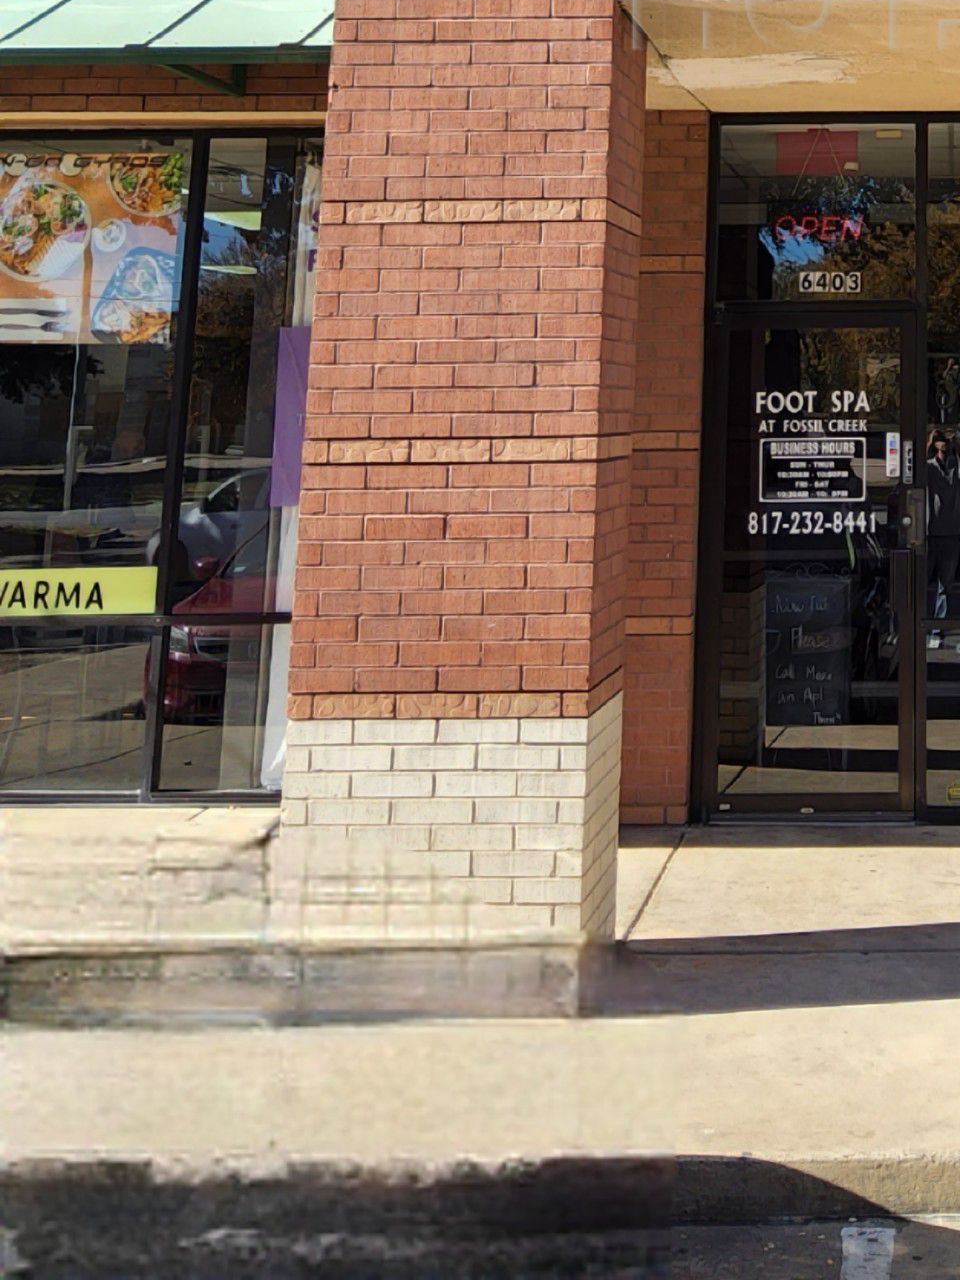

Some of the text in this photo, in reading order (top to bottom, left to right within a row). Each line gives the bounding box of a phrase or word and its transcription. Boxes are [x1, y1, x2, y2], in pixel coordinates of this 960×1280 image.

[773, 214, 863, 241] OPEN
[801, 273, 860, 291] 6403
[755, 390, 870, 414] FOOT SPA
[758, 419, 868, 433] AT FOSSIL CREEK
[821, 441, 856, 454] HOURS
[748, 511, 876, 534] 817-232-8441
[0, 580, 103, 610] ARMA
